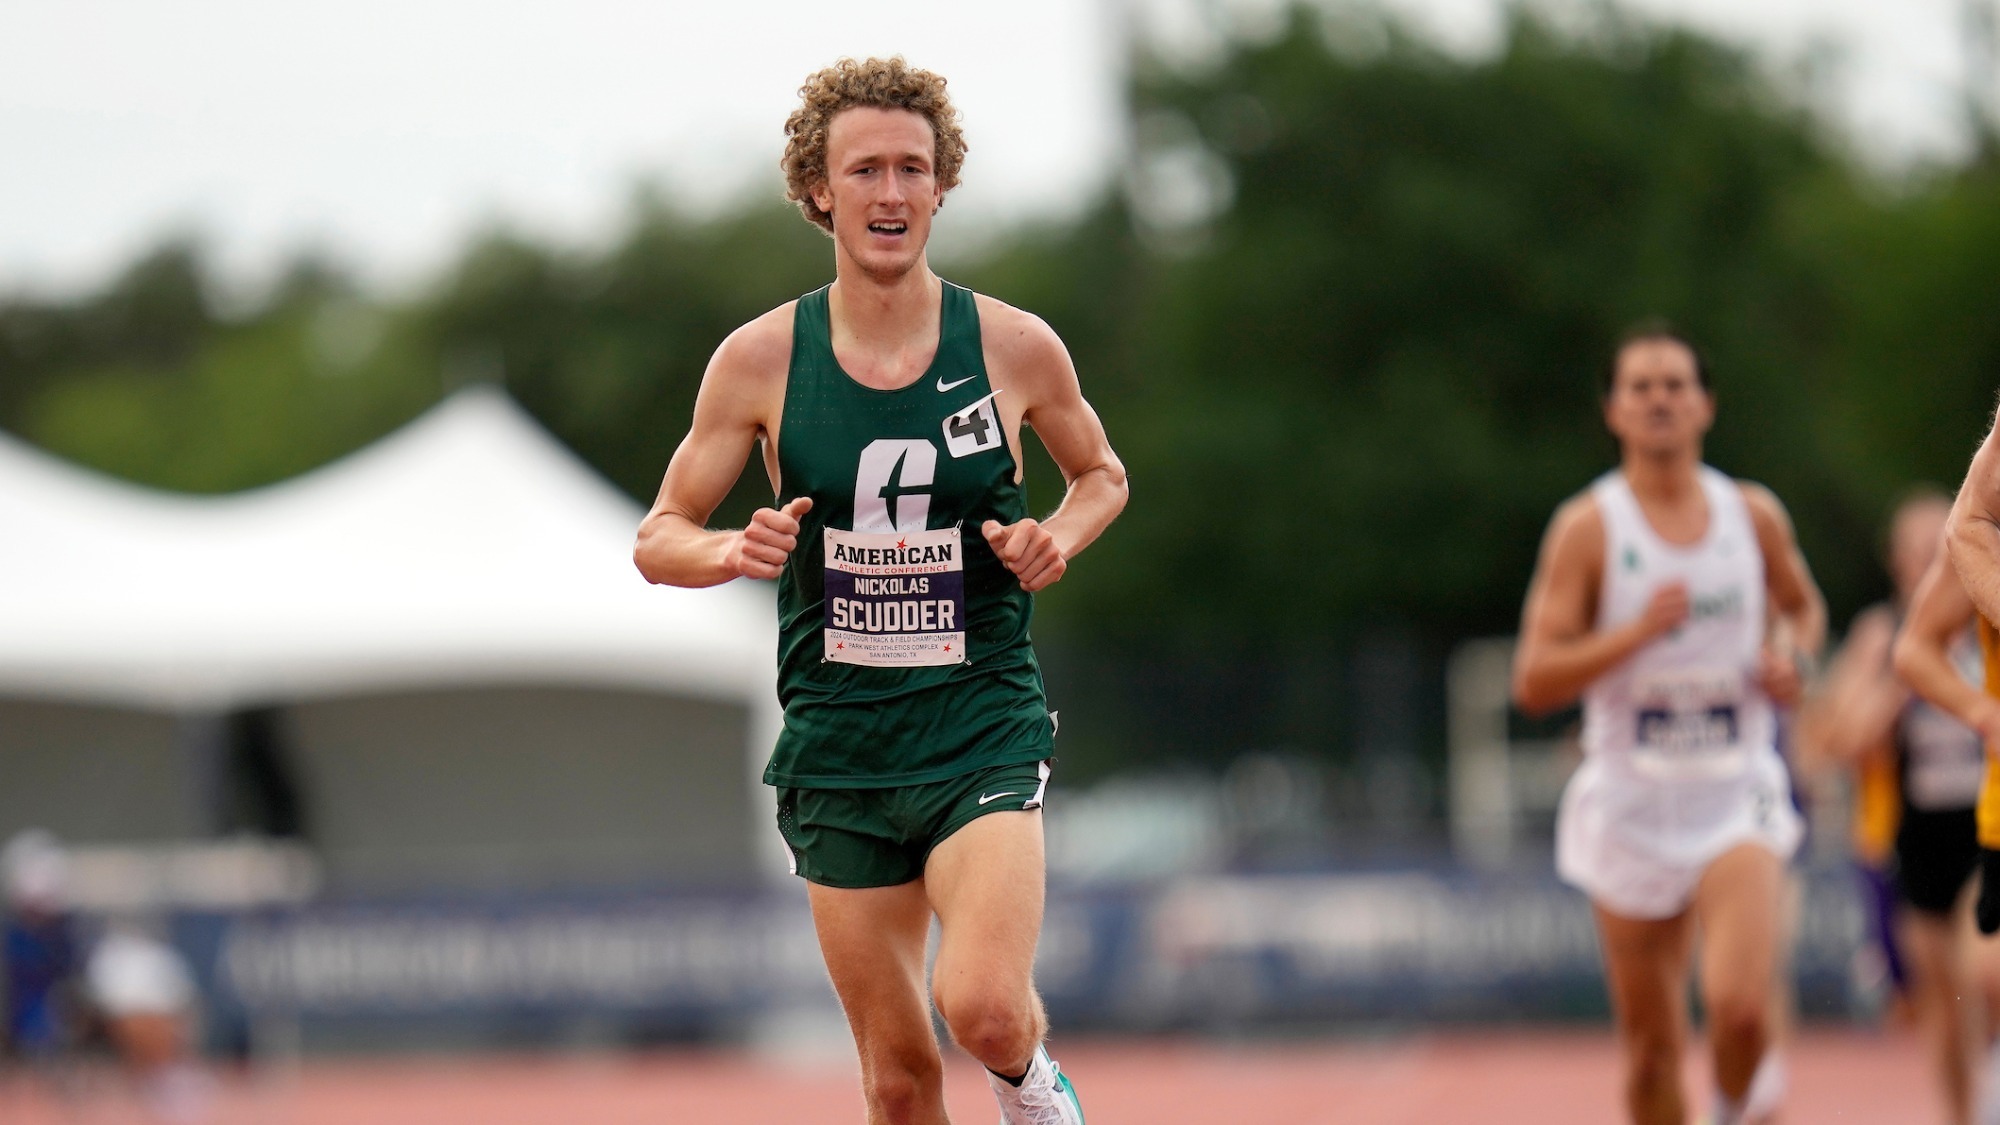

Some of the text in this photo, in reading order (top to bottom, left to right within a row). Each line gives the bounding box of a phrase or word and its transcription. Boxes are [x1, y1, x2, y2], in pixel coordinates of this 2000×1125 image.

[833, 543, 953, 566] AMERICAN
[838, 563, 948, 574] ATHLETIC CONFERENCE
[854, 577, 929, 596] NICKOLAS
[832, 596, 955, 632] SCUDDER
[830, 631, 842, 639] 2024
[843, 634, 868, 643] OUTDOOR
[912, 634, 958, 643] CHAMPIONSHIPS
[881, 643, 910, 651] ATHLETICS
